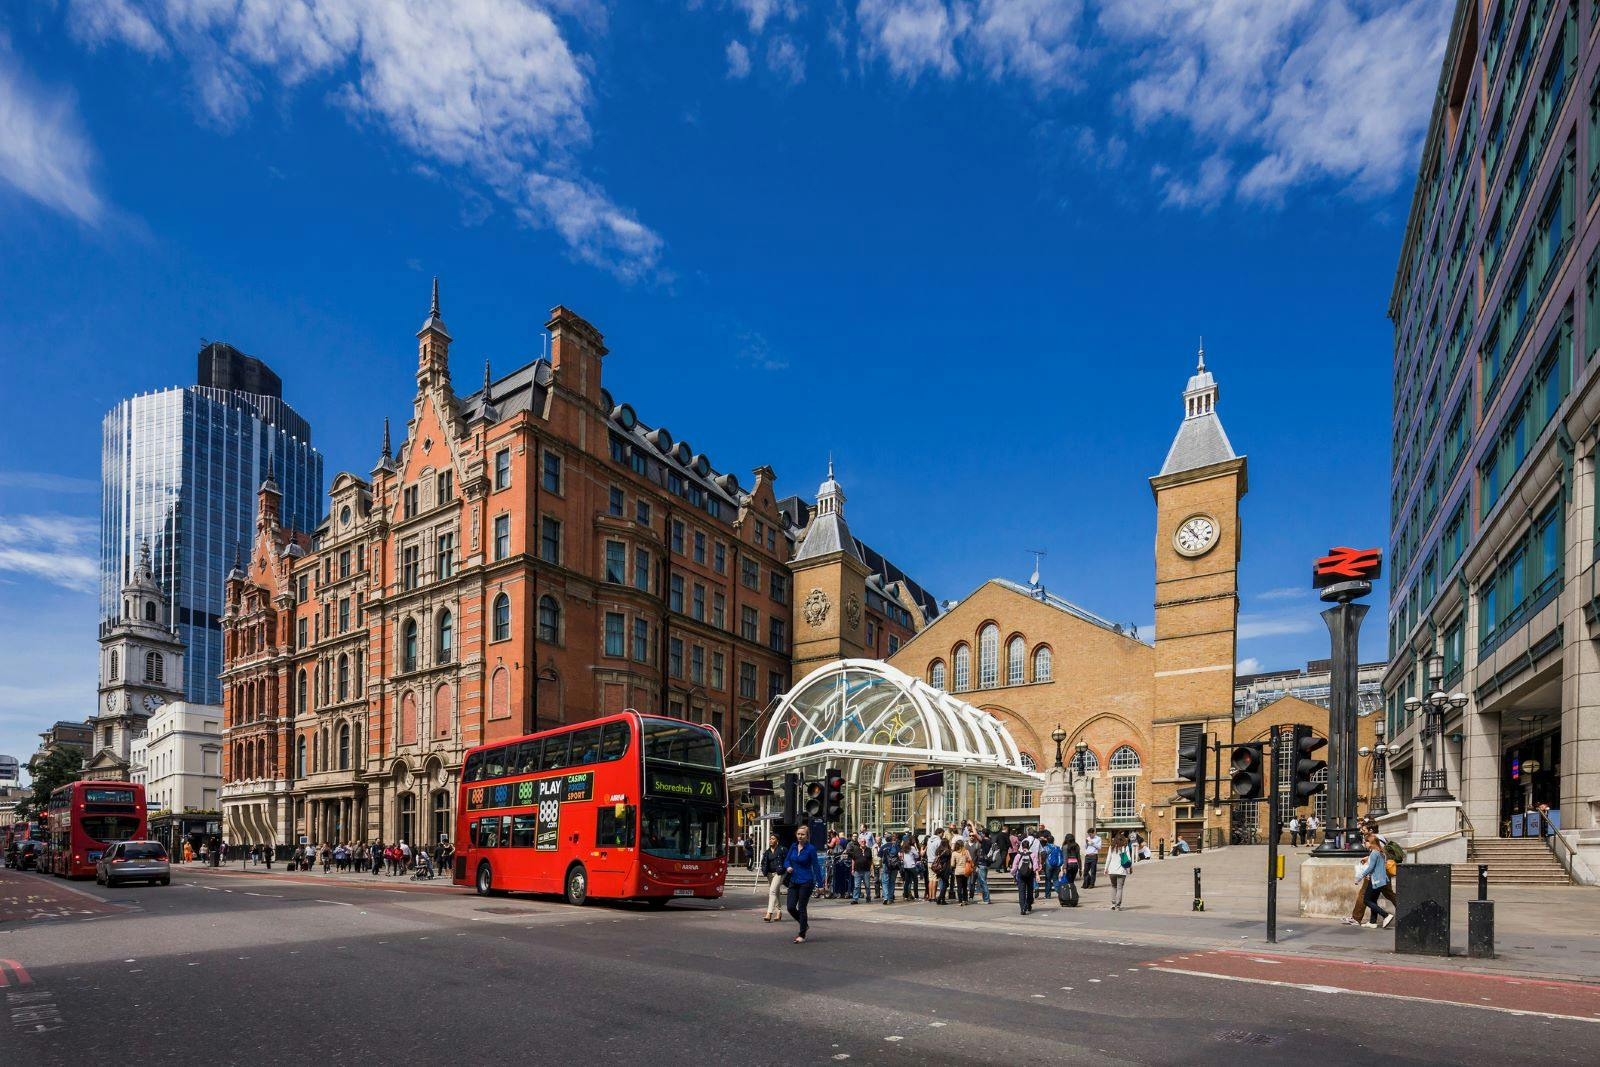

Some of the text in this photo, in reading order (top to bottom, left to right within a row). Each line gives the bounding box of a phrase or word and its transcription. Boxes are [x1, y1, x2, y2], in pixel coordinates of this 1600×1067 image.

[568, 774, 586, 782] CASINO
[495, 784, 508, 802] 888
[519, 781, 533, 799] 888
[540, 780, 562, 795] PLAY
[655, 781, 712, 795] Shoreditch 78
[472, 788, 484, 804] 888
[567, 791, 585, 800] SPORT
[539, 800, 558, 822] 888
